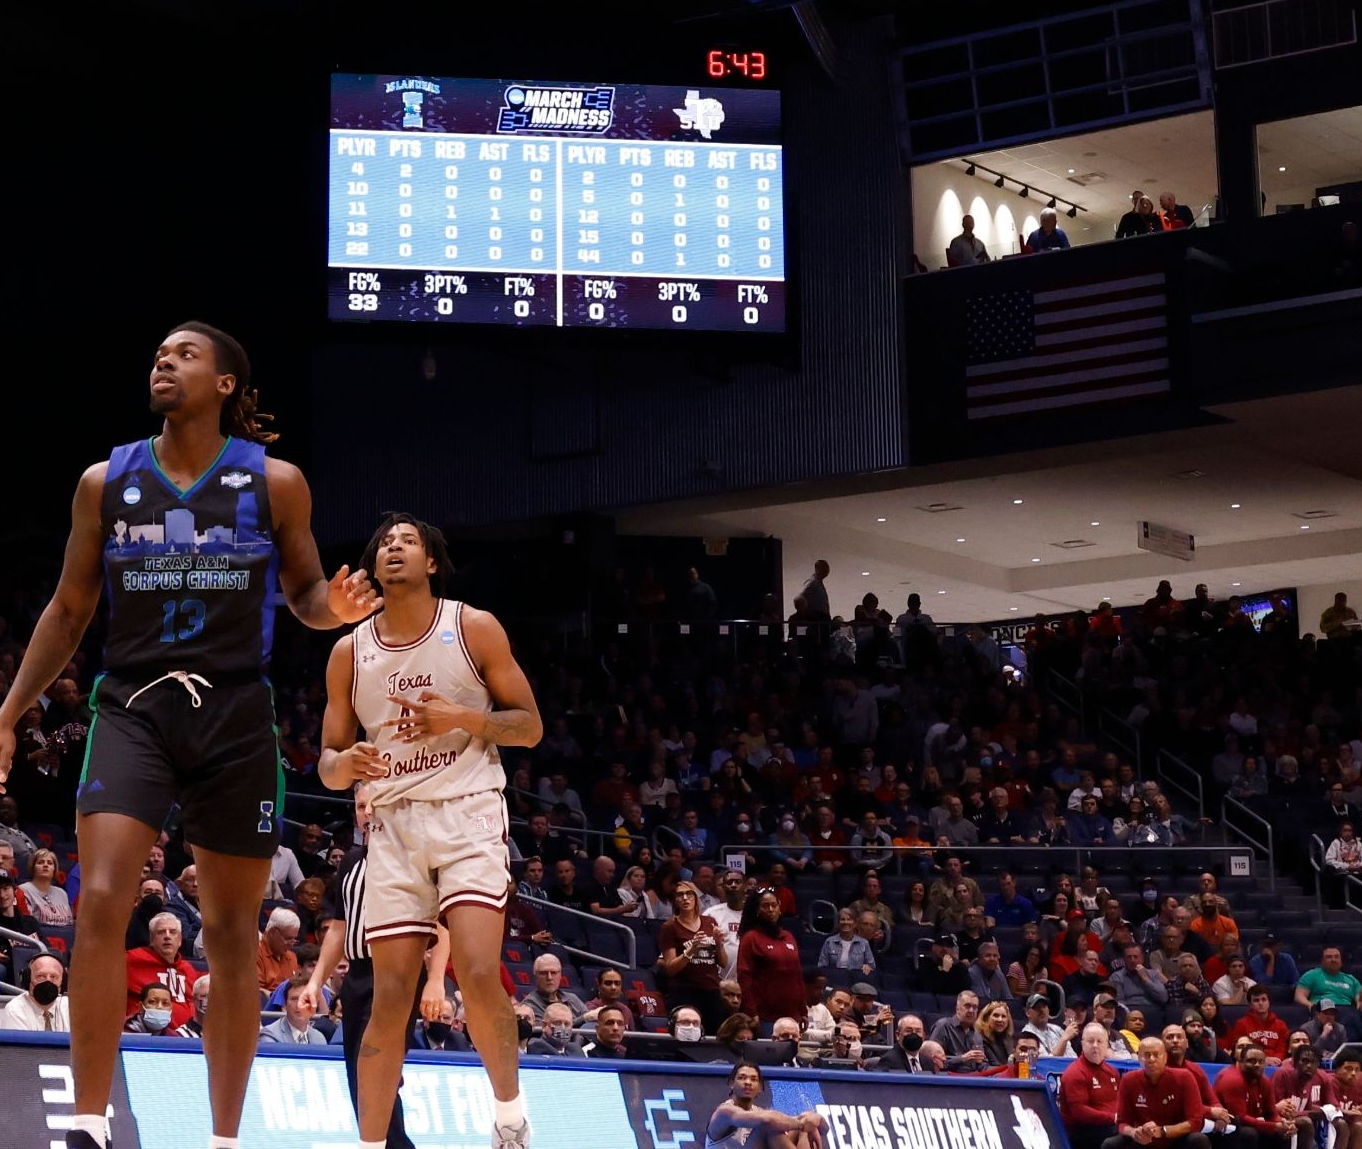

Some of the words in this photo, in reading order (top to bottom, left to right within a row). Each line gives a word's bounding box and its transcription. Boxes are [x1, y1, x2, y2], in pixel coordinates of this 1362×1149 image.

[709, 51, 765, 78] 6:43
[525, 90, 583, 108] MARCH
[531, 108, 611, 128] MADNESS
[337, 137, 377, 156] PLYR
[389, 138, 422, 159] PTS
[434, 140, 466, 160] REB
[478, 142, 510, 161] AST
[522, 143, 550, 163] FLS
[567, 145, 607, 165] PLYR
[619, 147, 652, 167] PTS
[664, 148, 695, 168] REB
[707, 150, 737, 170] AST
[749, 152, 777, 171] FLS
[351, 162, 365, 176] 4
[400, 163, 413, 178] 2
[445, 165, 458, 180] 0
[488, 167, 502, 181] 0
[529, 168, 543, 183] 0
[582, 170, 595, 185] 2
[630, 172, 644, 187] 0
[673, 174, 687, 189] 0
[715, 175, 729, 190] 0
[757, 177, 770, 192] 0
[347, 181, 369, 196] 10
[398, 183, 413, 198] 0
[444, 185, 459, 200] 0
[489, 186, 503, 201] 0
[529, 188, 543, 203] 0
[581, 189, 596, 204] 5
[629, 191, 644, 206] 0
[675, 193, 686, 208] 1
[715, 194, 730, 209] 0
[756, 196, 771, 211] 0
[348, 201, 368, 216] 11
[398, 202, 413, 218] 0
[446, 204, 457, 219] 1
[490, 206, 501, 221] 1
[529, 207, 543, 222] 0
[578, 209, 600, 224] 12
[630, 210, 644, 225] 0
[673, 212, 687, 227] 0
[716, 214, 730, 228] 0
[757, 216, 771, 231] 0
[347, 221, 369, 237] 13
[399, 223, 413, 238] 0
[444, 225, 458, 239] 0
[489, 226, 502, 241] 0
[530, 228, 544, 243] 0
[579, 229, 600, 244] 15
[631, 231, 644, 246] 0
[674, 233, 687, 247] 0
[717, 234, 730, 249] 0
[758, 237, 771, 251] 0
[345, 241, 369, 256] 22
[398, 243, 413, 257] 0
[444, 244, 458, 259] 0
[488, 246, 502, 260] 0
[530, 247, 544, 262] 0
[577, 249, 600, 264] 44
[631, 251, 644, 265] 0
[676, 252, 686, 267] 1
[717, 253, 730, 268] 0
[758, 254, 772, 269] 0
[349, 273, 381, 293] FG%
[424, 275, 468, 294] 3PT%
[504, 277, 535, 296] FT%
[584, 280, 617, 300] FG%
[658, 282, 701, 302] 3PT%
[737, 285, 768, 305] FT%
[348, 294, 378, 311] 33
[438, 298, 453, 315] 0
[514, 301, 529, 317] 0
[589, 303, 604, 320] 0
[672, 305, 687, 323] 0
[744, 307, 758, 324] 0
[145, 556, 192, 570] TEXAS
[196, 555, 230, 570] A&M
[123, 570, 183, 591] CORPUS
[187, 570, 251, 591] CHRISTI
[159, 599, 207, 643] 13
[387, 670, 433, 696] Texas
[382, 746, 458, 779] Southern
[1234, 862, 1246, 870] 115
[256, 1064, 356, 1132] NCAA
[816, 1103, 891, 1149] TEXAS
[890, 1106, 1003, 1149] SOUTHERN
